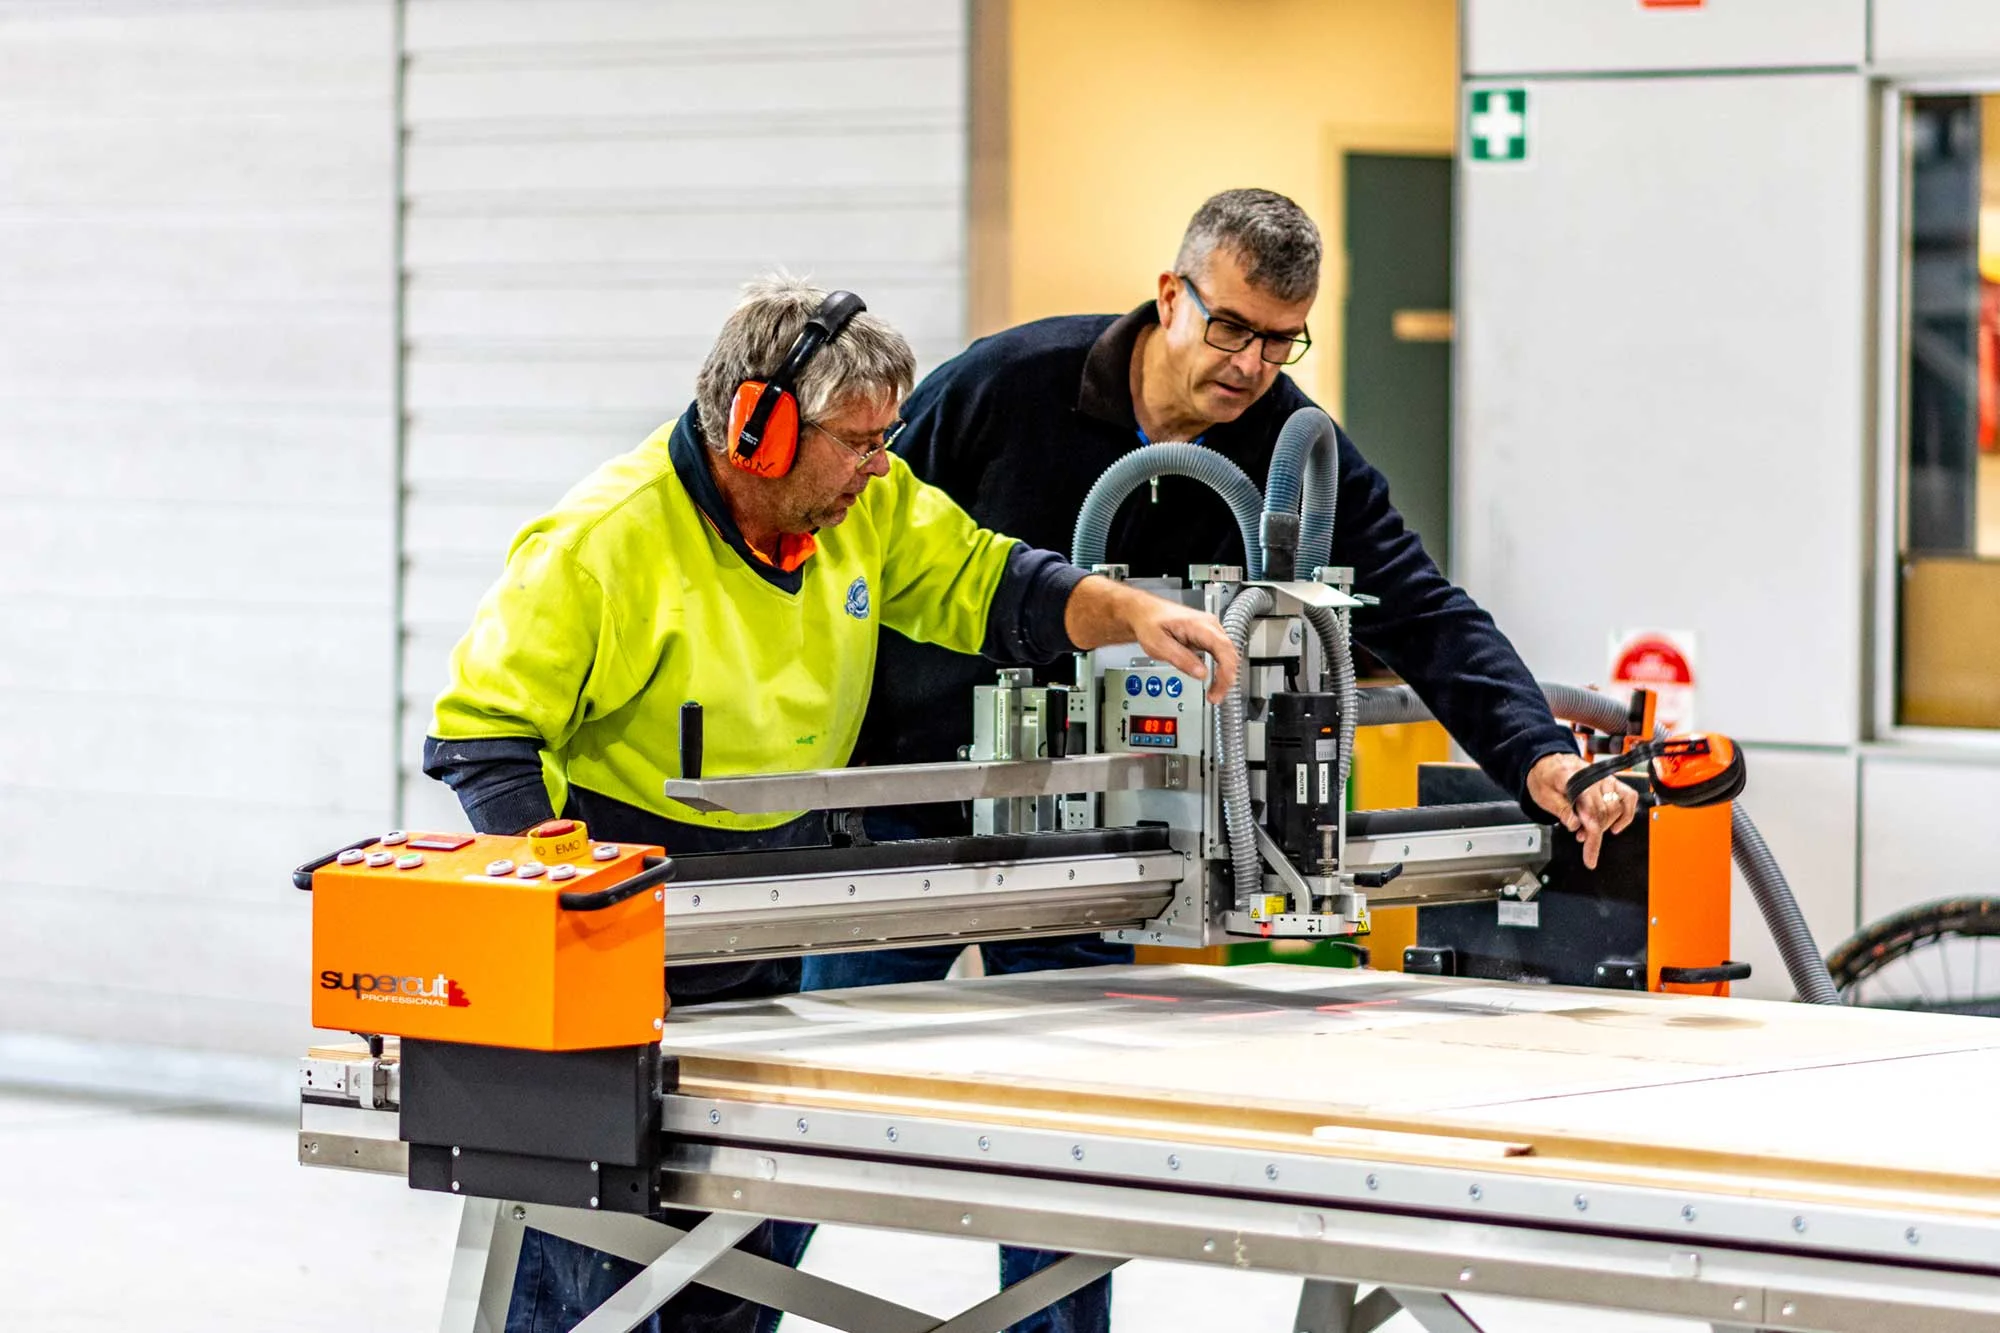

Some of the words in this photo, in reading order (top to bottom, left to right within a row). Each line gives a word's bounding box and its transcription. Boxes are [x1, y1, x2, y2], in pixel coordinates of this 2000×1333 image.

[555, 839, 581, 855] EMO
[320, 970, 449, 999] supercut
[361, 993, 447, 1007] PROFESSIONAL
